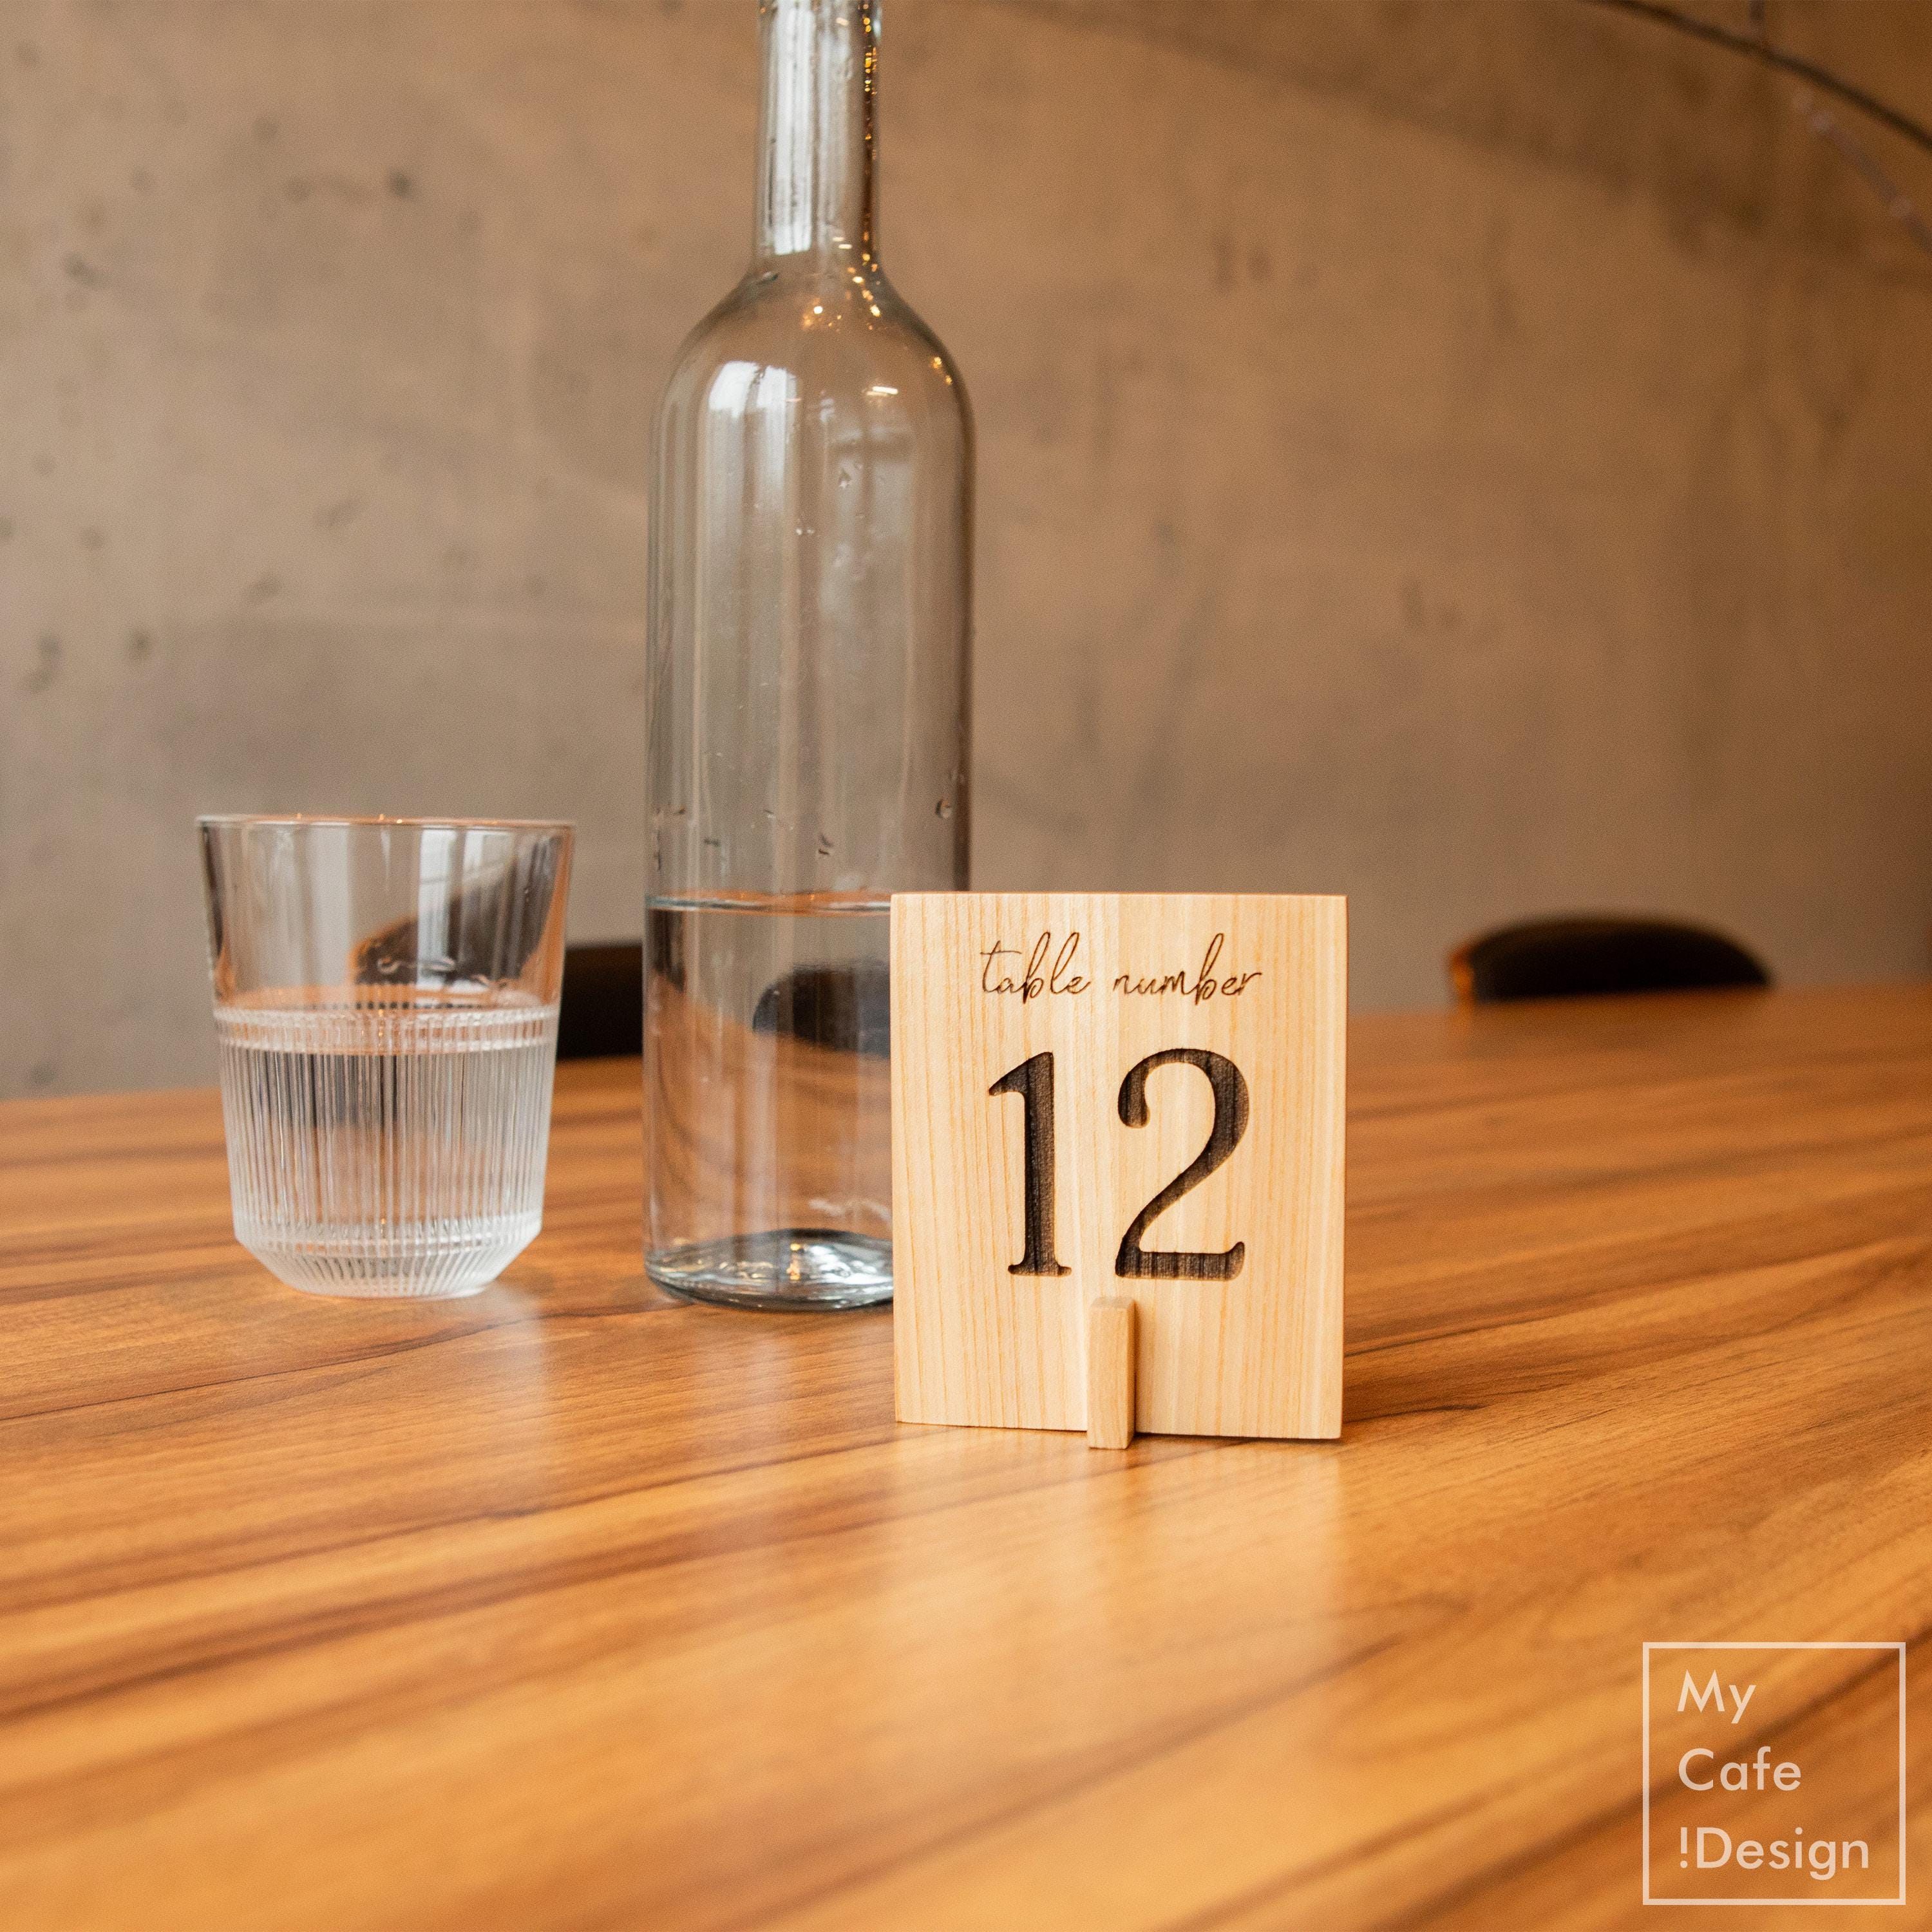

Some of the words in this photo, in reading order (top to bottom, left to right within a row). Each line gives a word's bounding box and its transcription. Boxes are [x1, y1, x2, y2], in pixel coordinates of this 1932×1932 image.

[980, 931, 1090, 1005] table
[1112, 933, 1262, 1005] number
[988, 1048, 1249, 1281] 12
